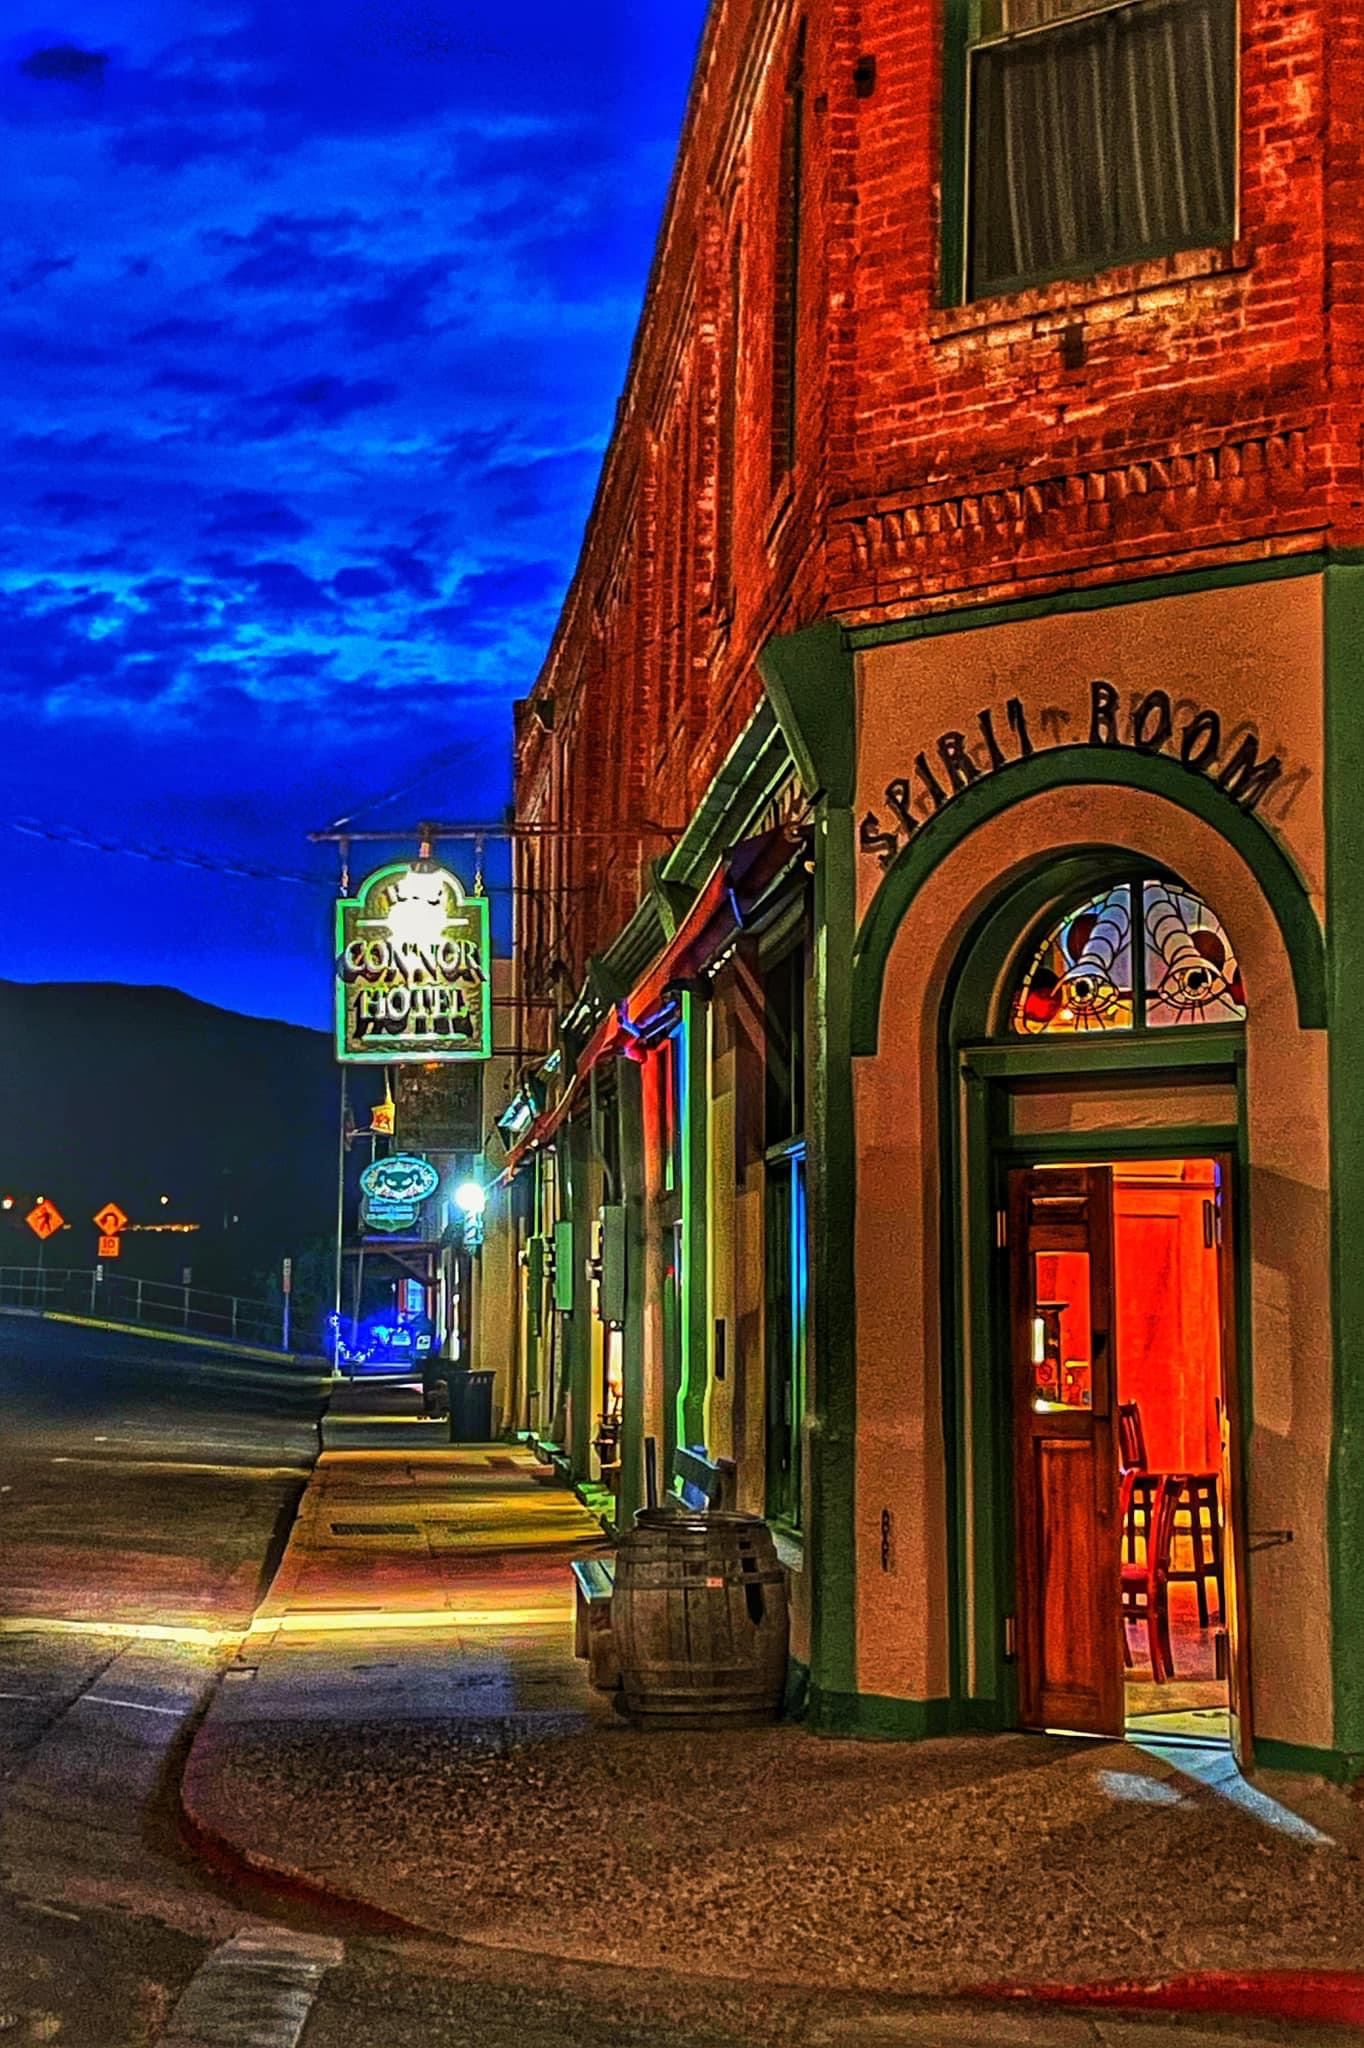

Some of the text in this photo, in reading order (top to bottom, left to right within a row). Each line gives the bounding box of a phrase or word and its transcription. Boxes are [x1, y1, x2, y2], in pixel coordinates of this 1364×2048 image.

[859, 697, 1034, 870] SPIRIT
[1089, 680, 1283, 813] ROOM
[344, 938, 483, 978] CONNOR
[358, 984, 470, 1022] HOTEL
